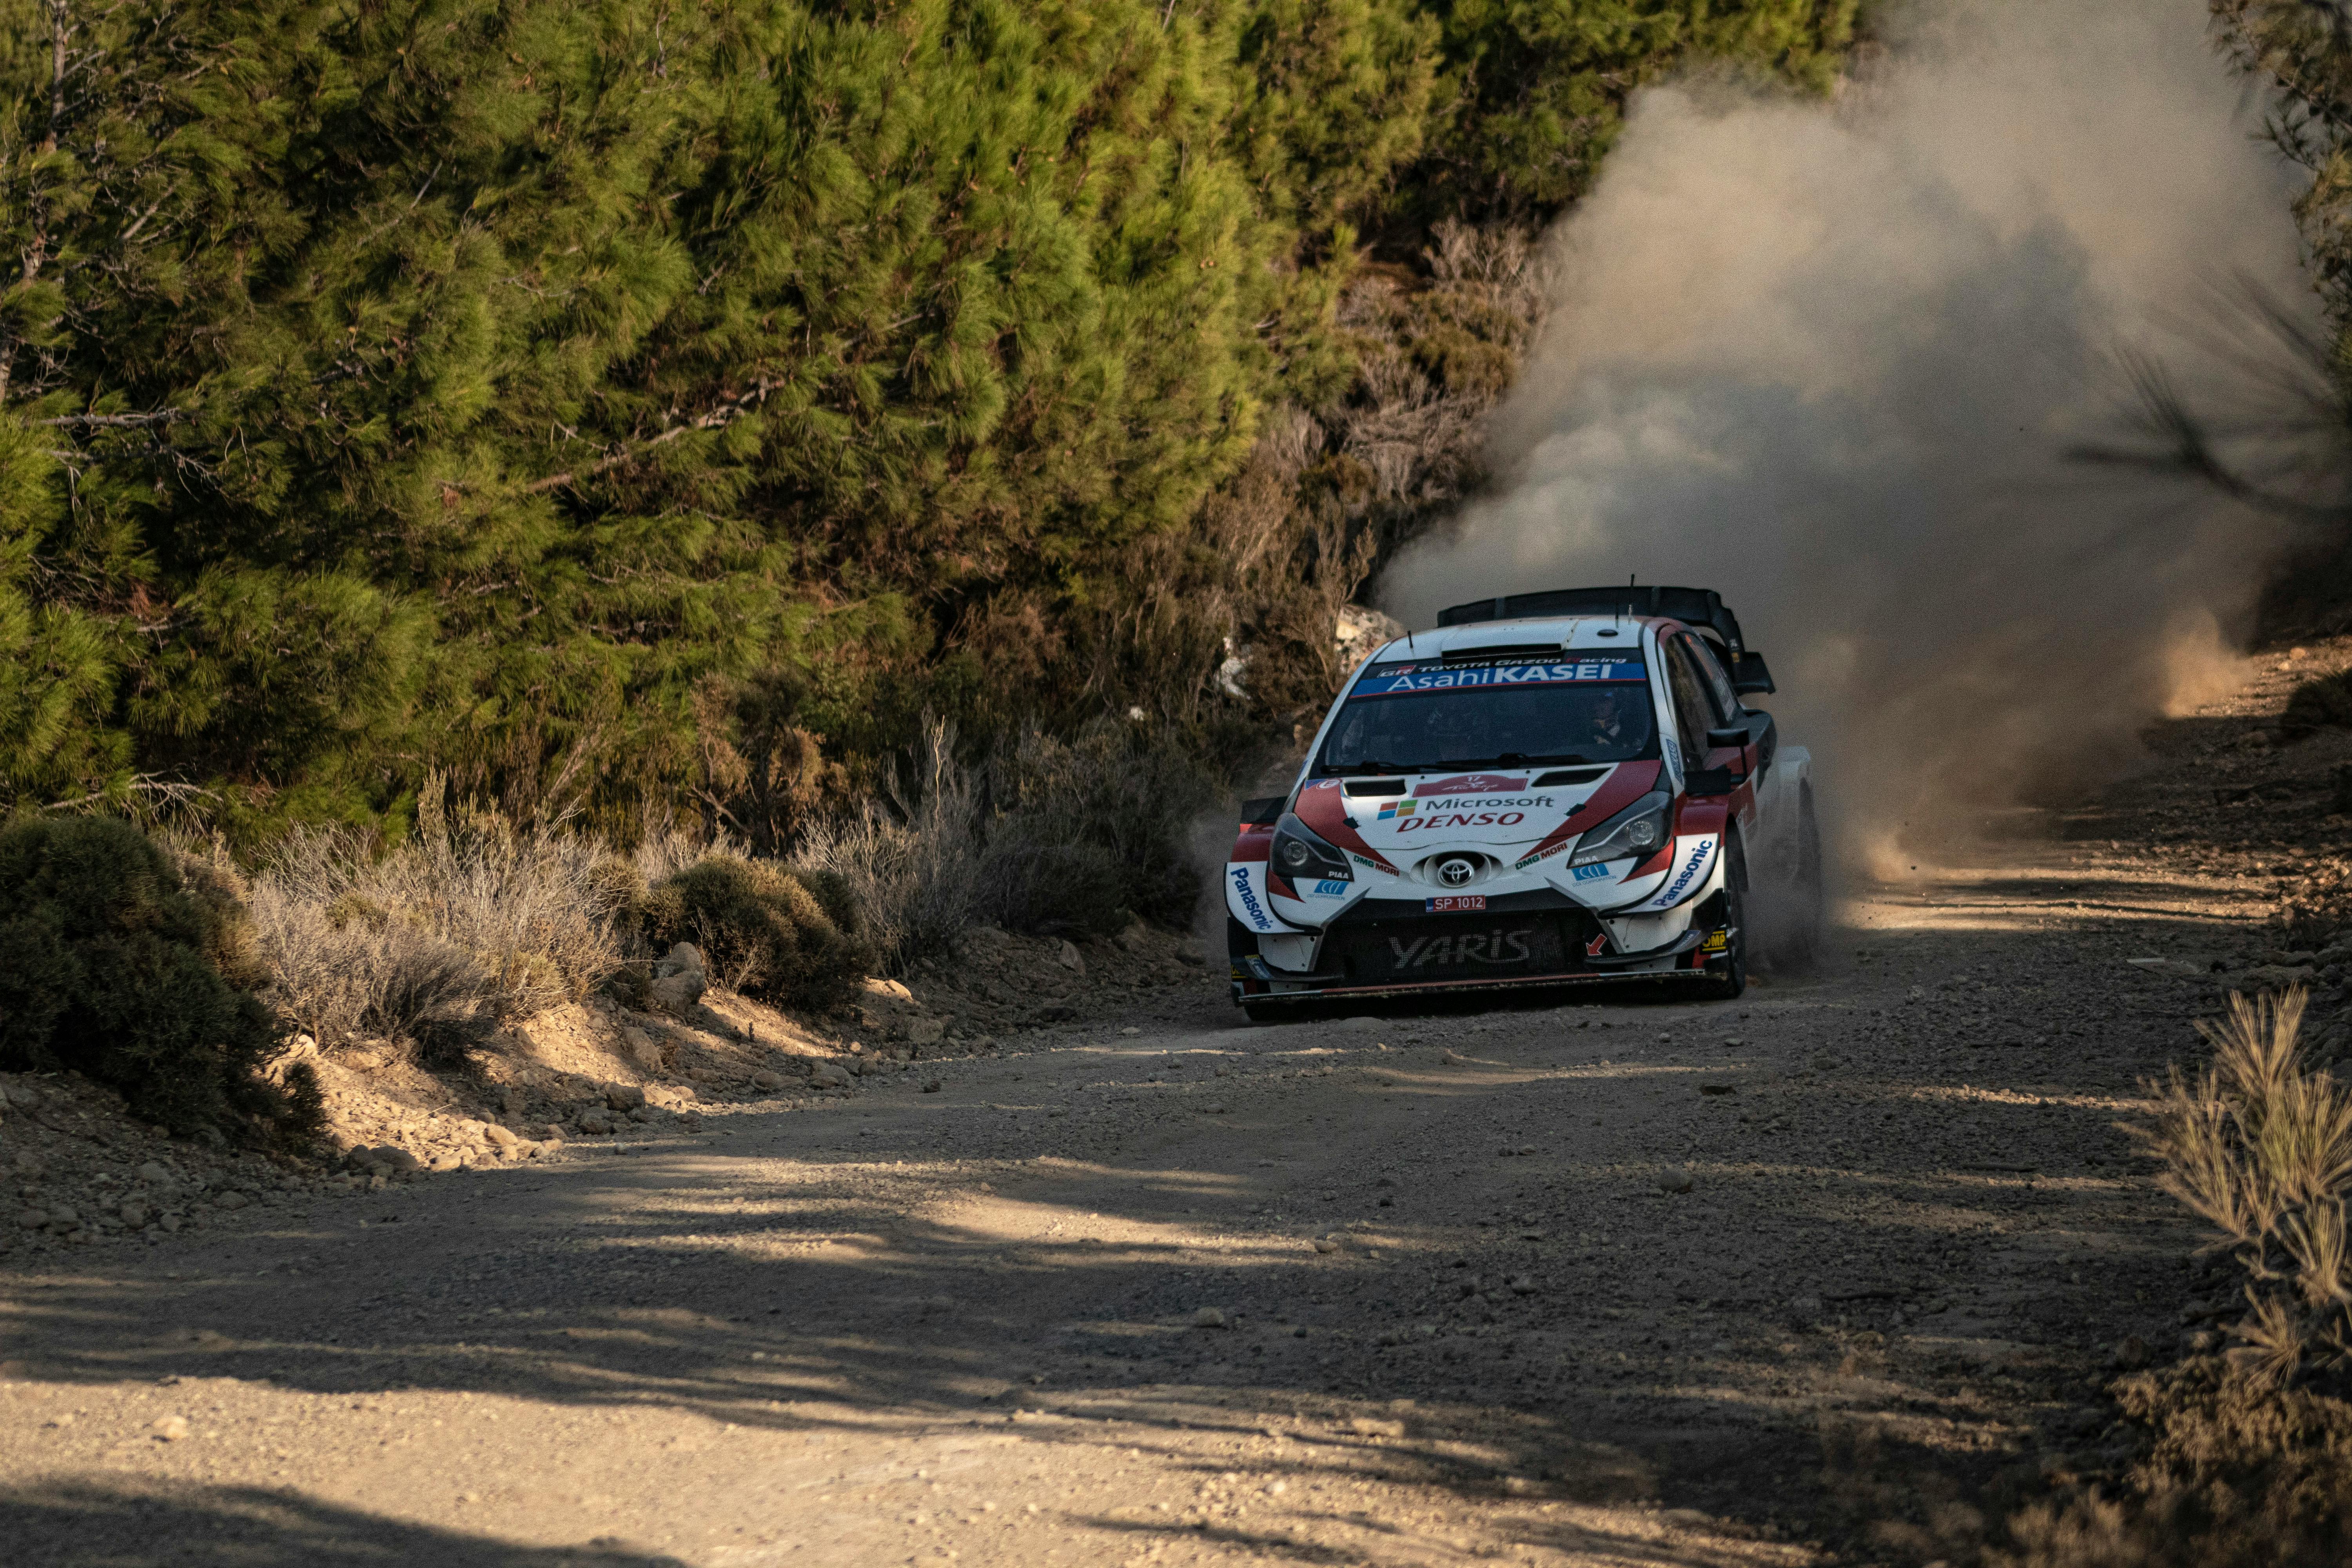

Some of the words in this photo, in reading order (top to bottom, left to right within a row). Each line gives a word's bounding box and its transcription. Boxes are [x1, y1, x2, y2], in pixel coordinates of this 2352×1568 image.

[1419, 662, 1490, 672] TOYOTA
[1425, 796, 1554, 810] Microsoft
[1396, 812, 1524, 832] DENSO
[1515, 855, 1539, 870] DMG
[1540, 842, 1567, 859] MORI
[1574, 855, 1598, 865] PIAA
[1354, 855, 1374, 867] DMG
[1375, 863, 1399, 877] MORI
[1651, 840, 1712, 906] Panasonic
[1328, 871, 1348, 879] PIAA
[1230, 867, 1272, 930] Panasonic
[1435, 898, 1452, 909] SP
[1457, 897, 1483, 908] 1012
